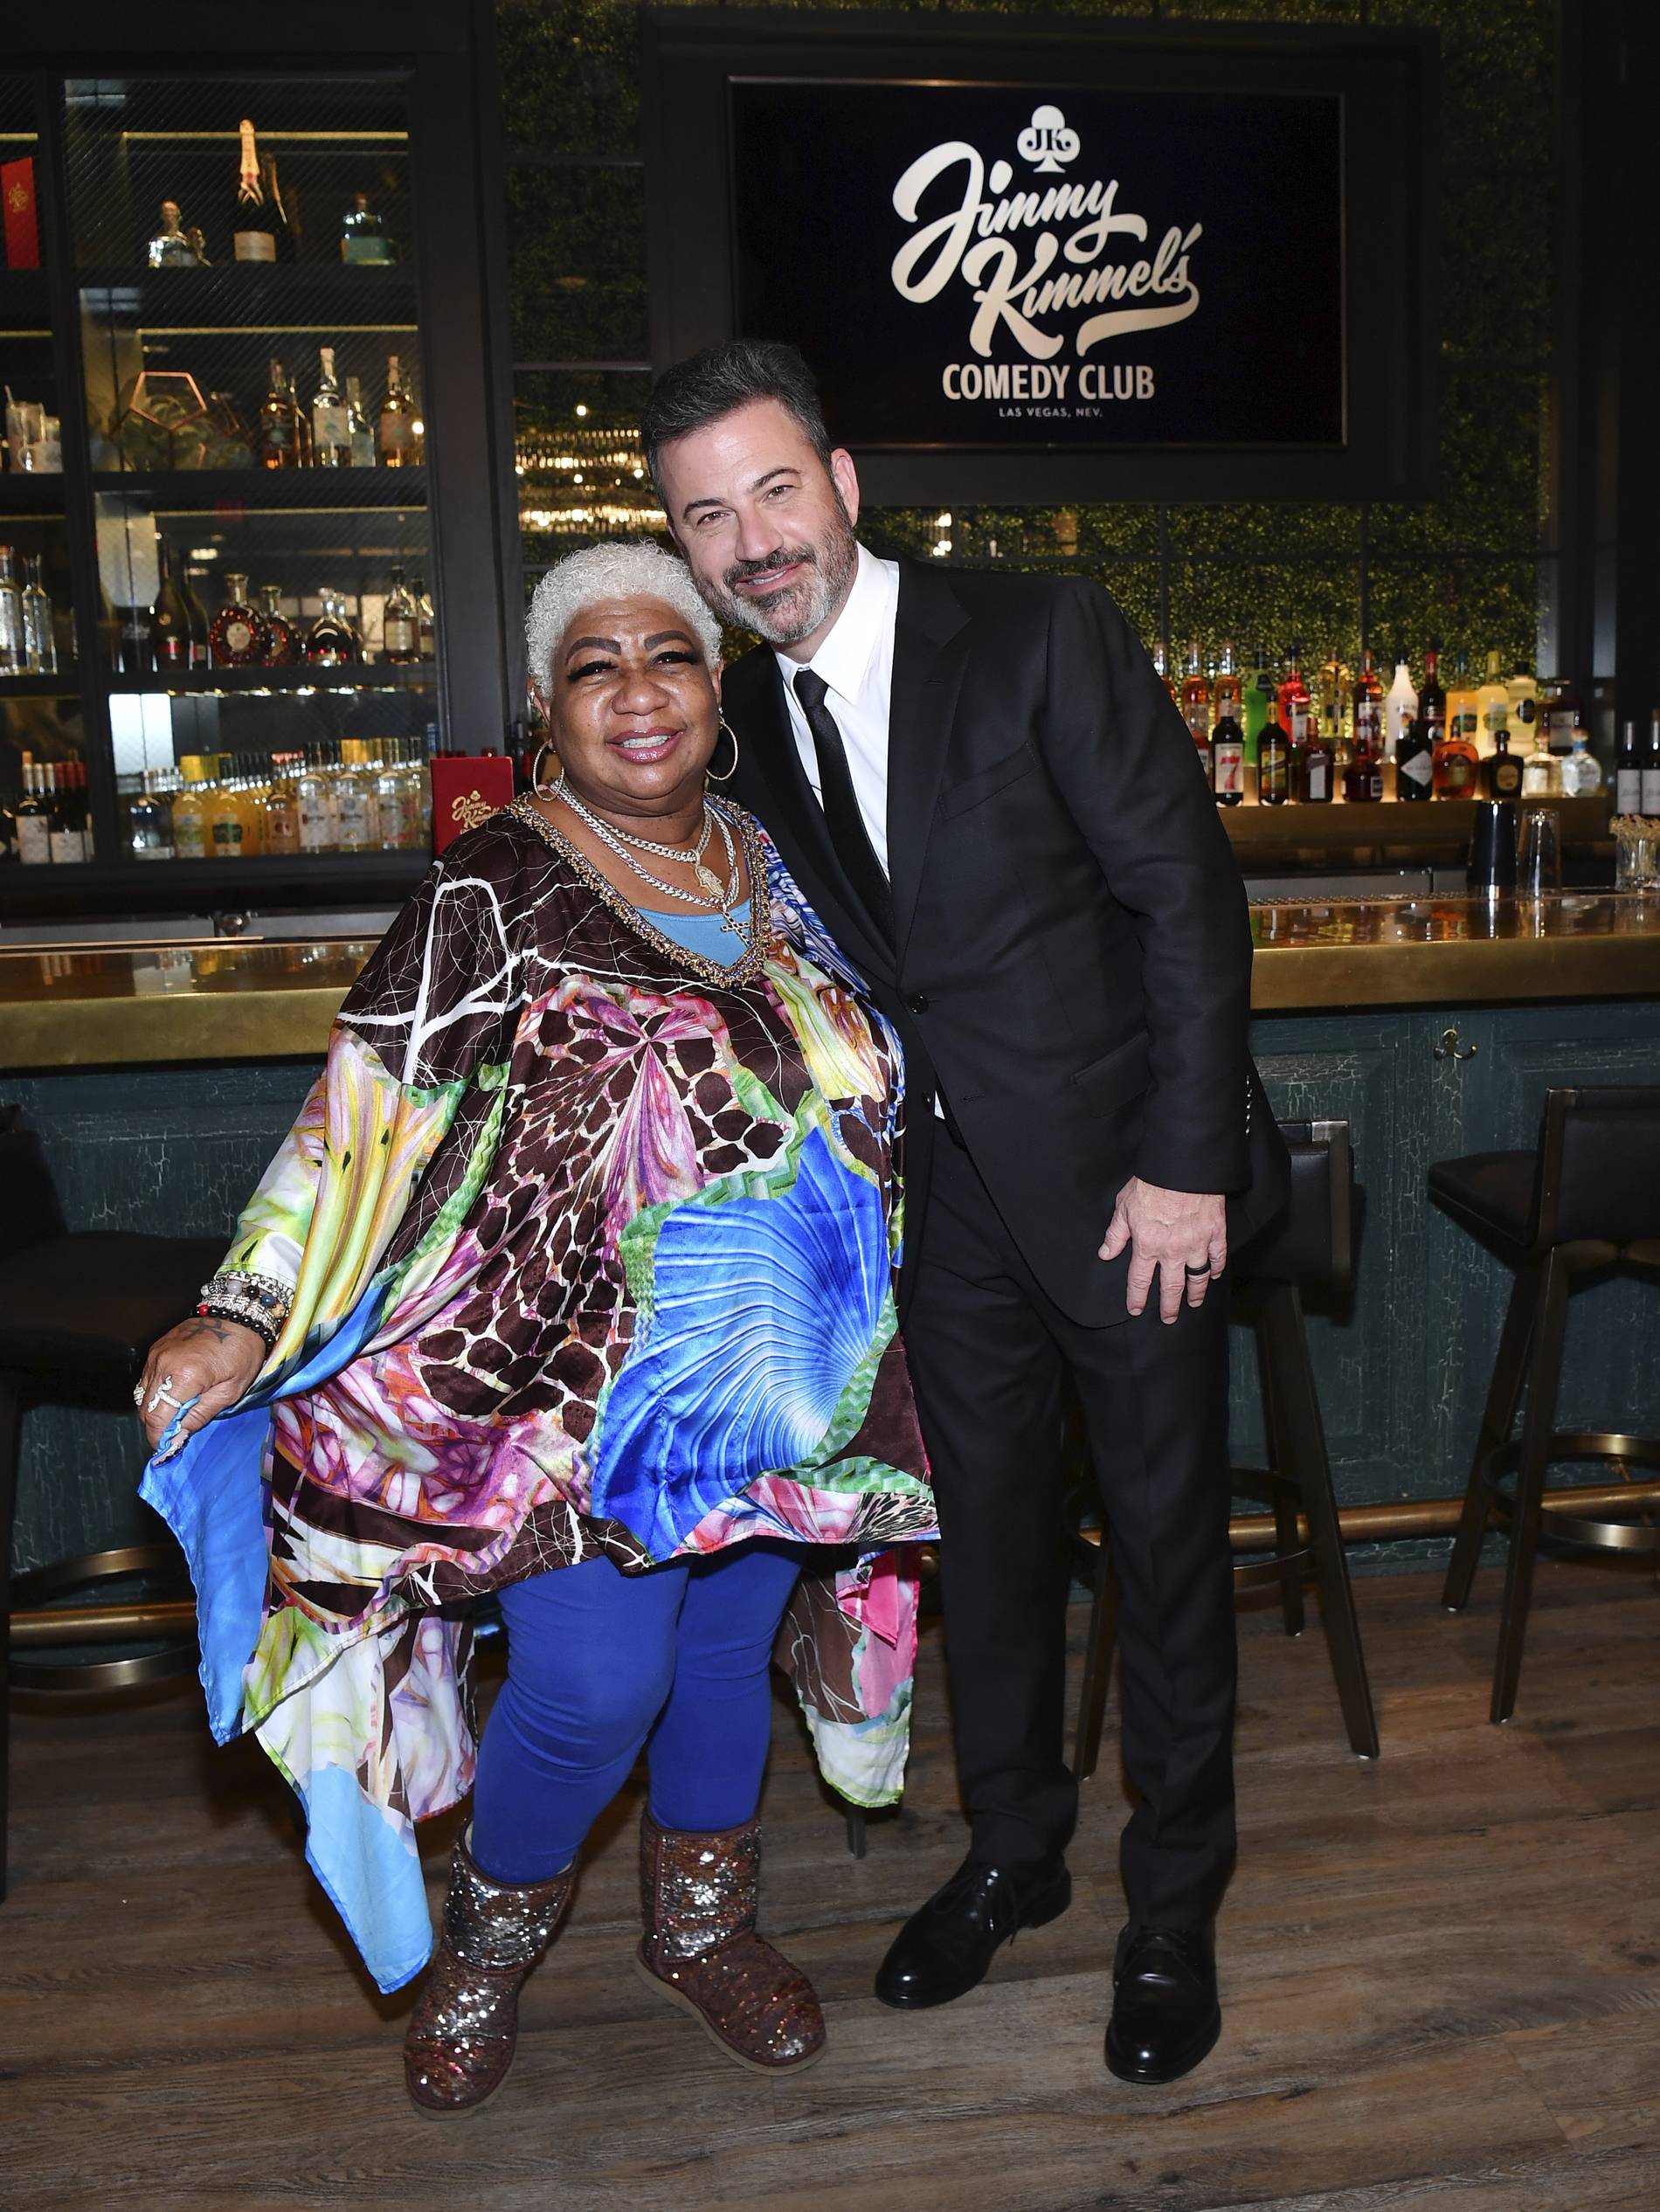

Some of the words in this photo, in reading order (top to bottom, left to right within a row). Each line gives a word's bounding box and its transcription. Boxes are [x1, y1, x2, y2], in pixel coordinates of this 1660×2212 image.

[891, 141, 1148, 303] Jimmy
[961, 222, 1203, 360] Kimmel's
[942, 363, 1070, 400] COMEDY
[1078, 364, 1155, 400] CLUB
[999, 407, 1022, 418] LAS
[1026, 407, 1071, 419] VEGAS,
[1076, 407, 1103, 418] NEV.
